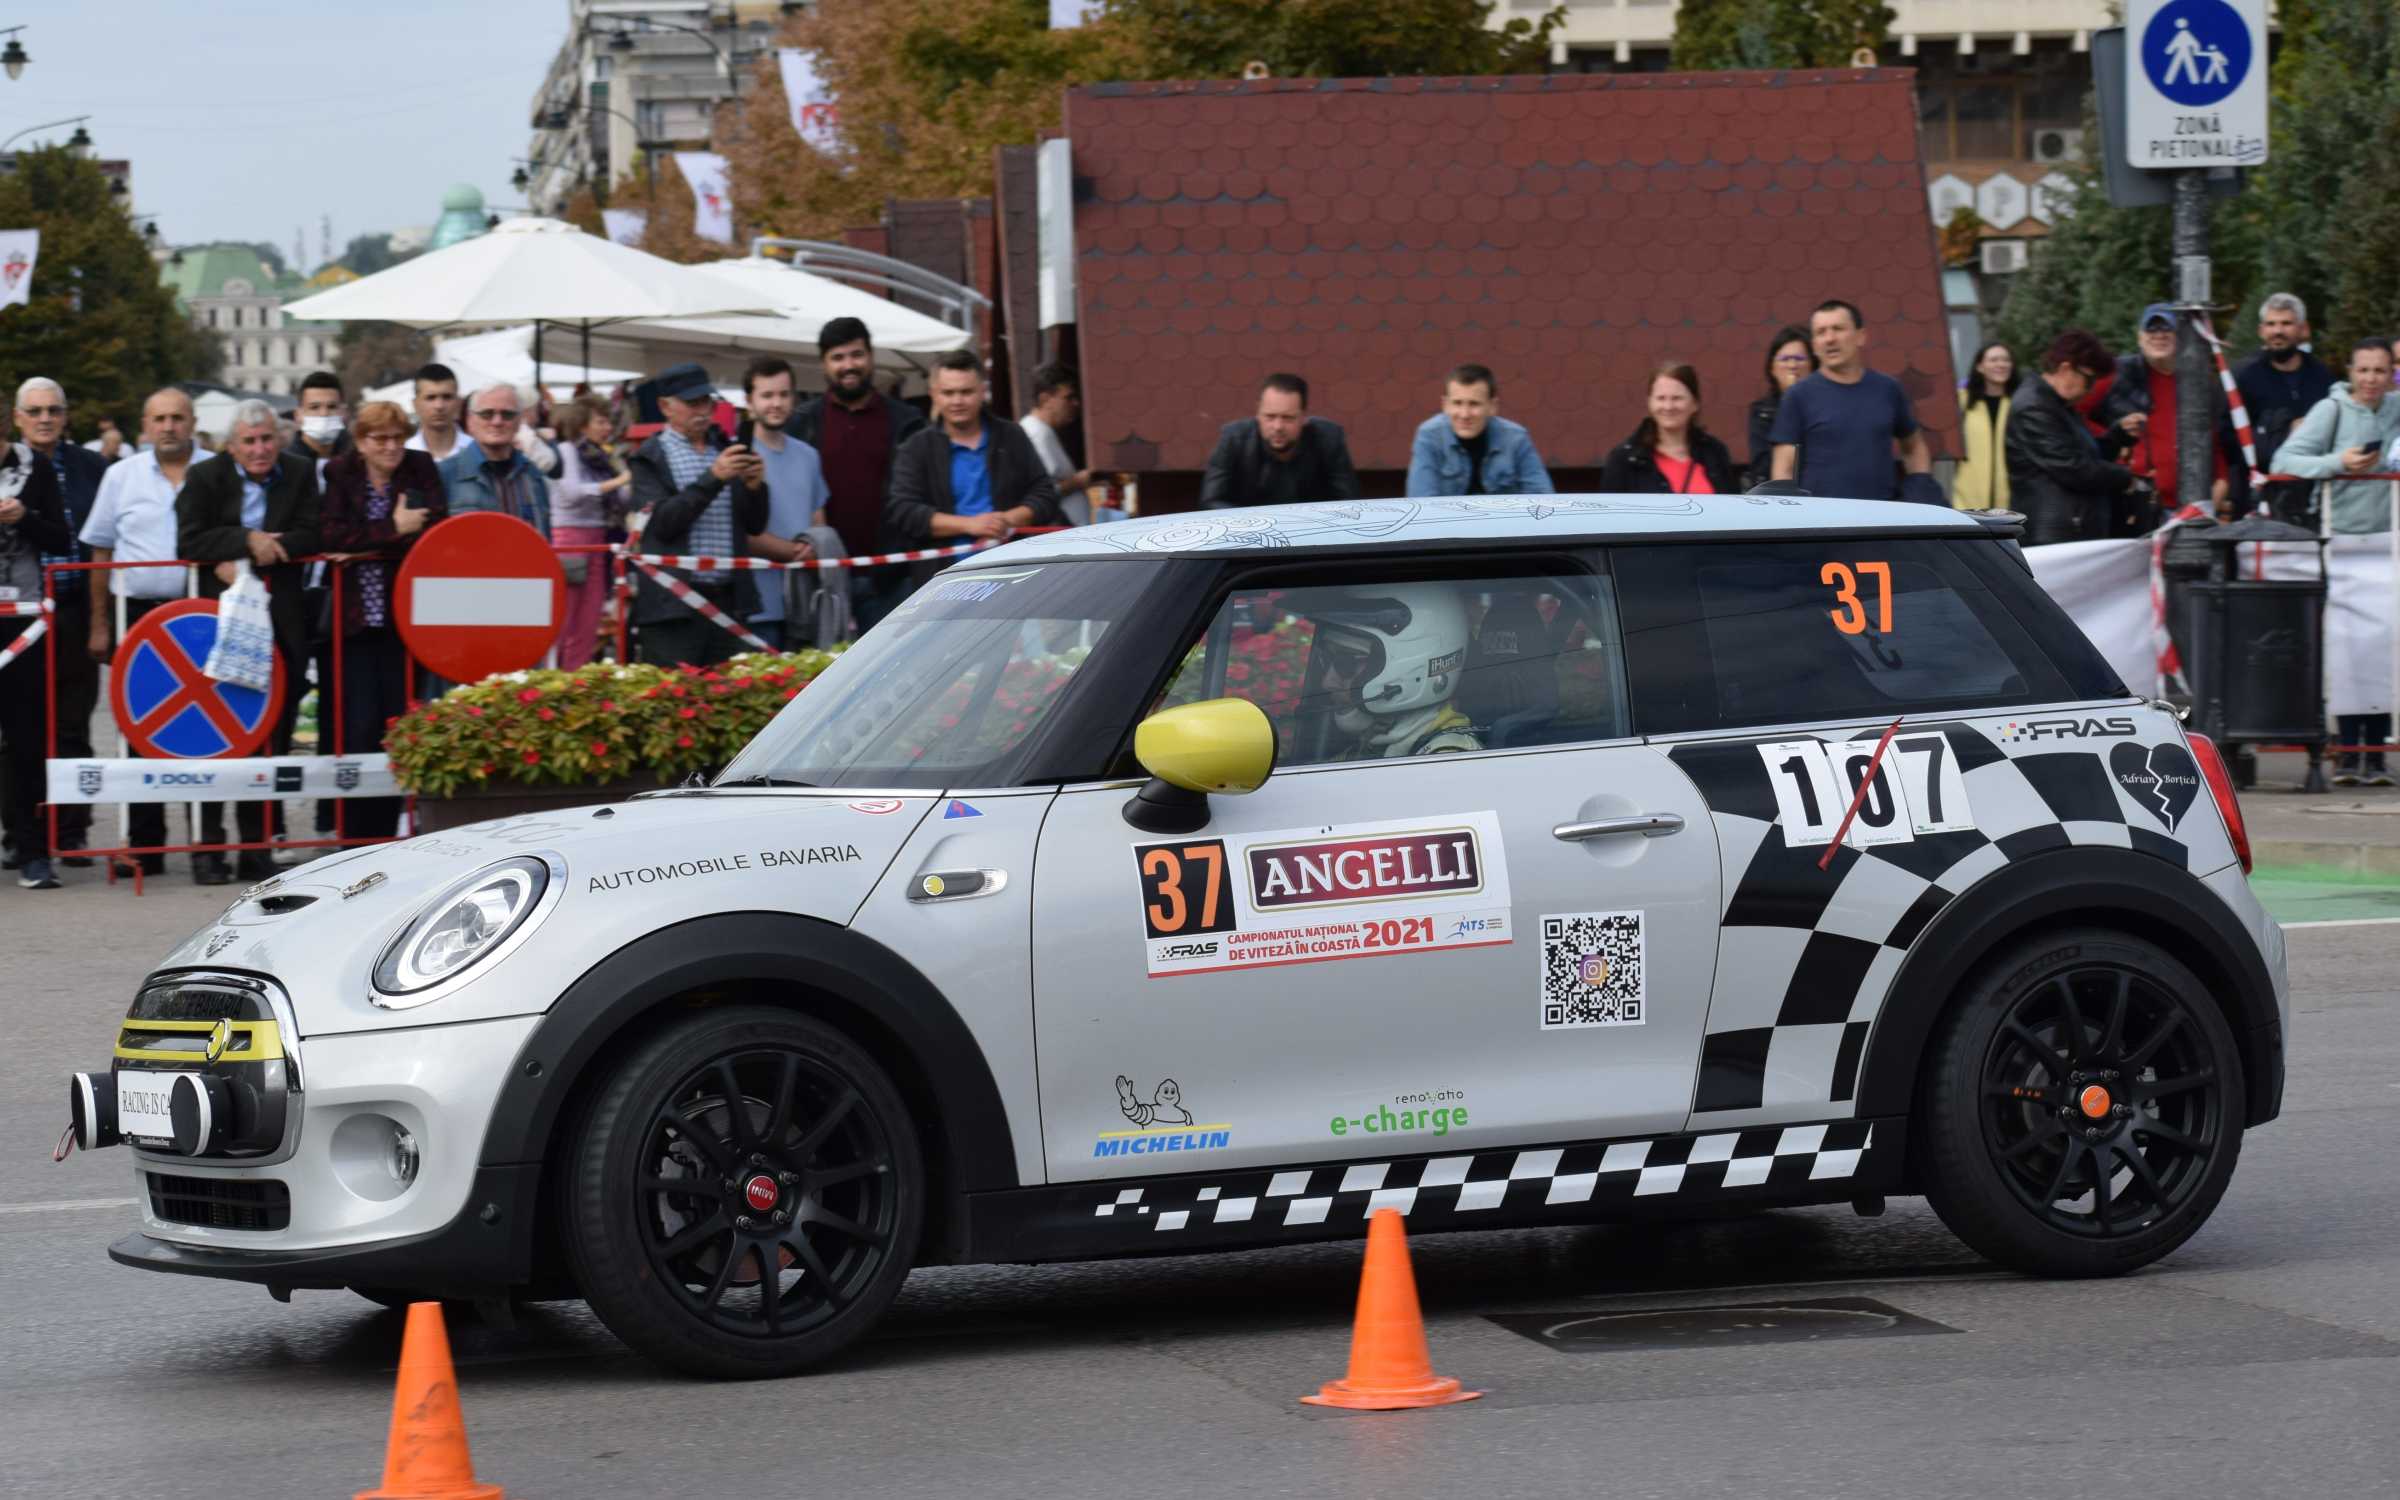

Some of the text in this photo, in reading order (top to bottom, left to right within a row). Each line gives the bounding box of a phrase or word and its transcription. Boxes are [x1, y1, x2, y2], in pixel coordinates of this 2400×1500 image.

[1820, 561, 1892, 635] 37
[2026, 717, 2137, 738] FRAS
[160, 772, 216, 785] DOLY
[1779, 735, 1945, 828] 107
[2120, 773, 2156, 785] Adrian
[588, 844, 862, 893] AUTOMOBILE BAVARIA
[1260, 841, 1473, 898] ANGELLI
[1143, 844, 1222, 933] 37
[1227, 926, 1304, 945] CAMPIONATUL
[1363, 916, 1435, 948] 2021
[1458, 919, 1485, 932] MTS
[1168, 941, 1219, 958] FRAS
[1229, 948, 1246, 961] DE
[1246, 942, 1294, 959] VITEZĂ
[1294, 941, 1310, 956] ÎN
[1311, 935, 1361, 954] COASTĂ
[122, 1090, 150, 1114] RACING
[151, 1093, 159, 1115] IS
[1330, 1104, 1468, 1137] e-charge
[1094, 1131, 1230, 1157] MICHELIN
